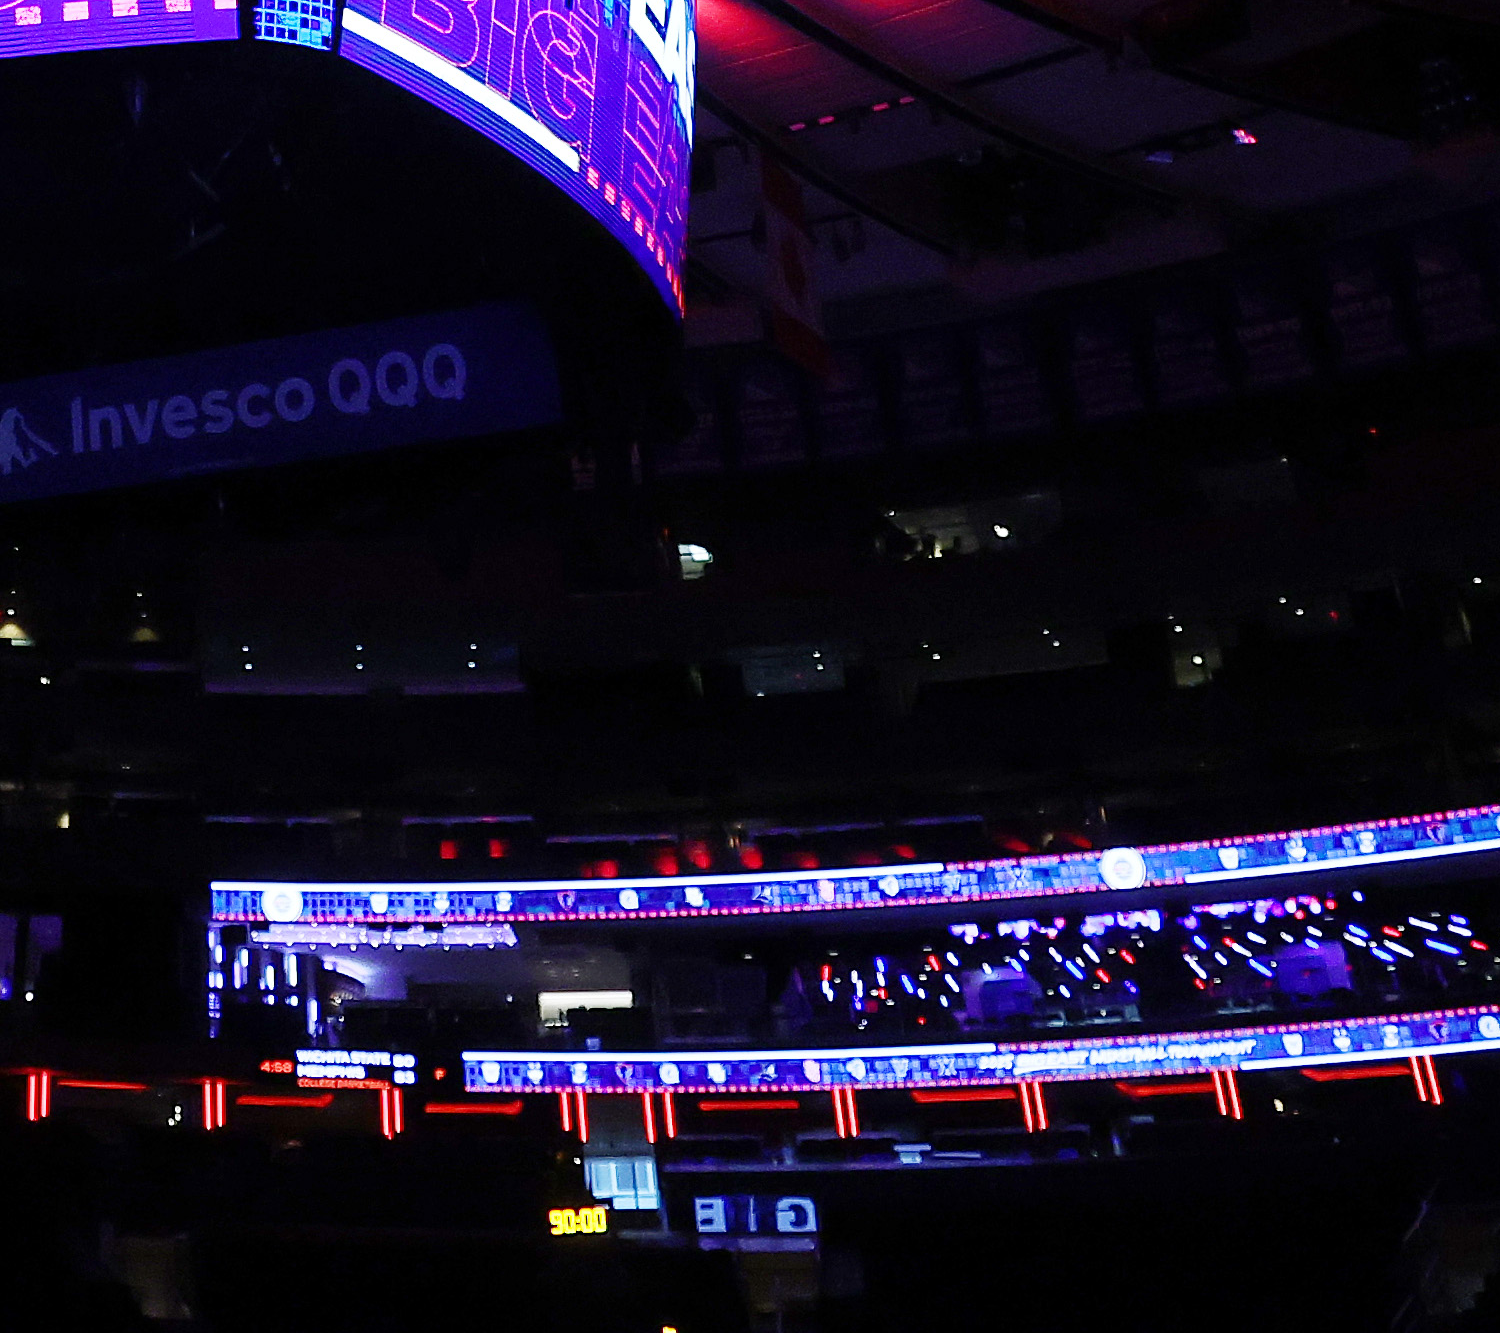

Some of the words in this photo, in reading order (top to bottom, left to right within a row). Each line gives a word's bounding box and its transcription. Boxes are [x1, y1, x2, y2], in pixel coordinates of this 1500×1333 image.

[69, 376, 317, 455] Invesco
[327, 341, 468, 416] QQQ
[350, 1050, 391, 1066] STATE
[548, 1205, 608, 1236] 90:00
